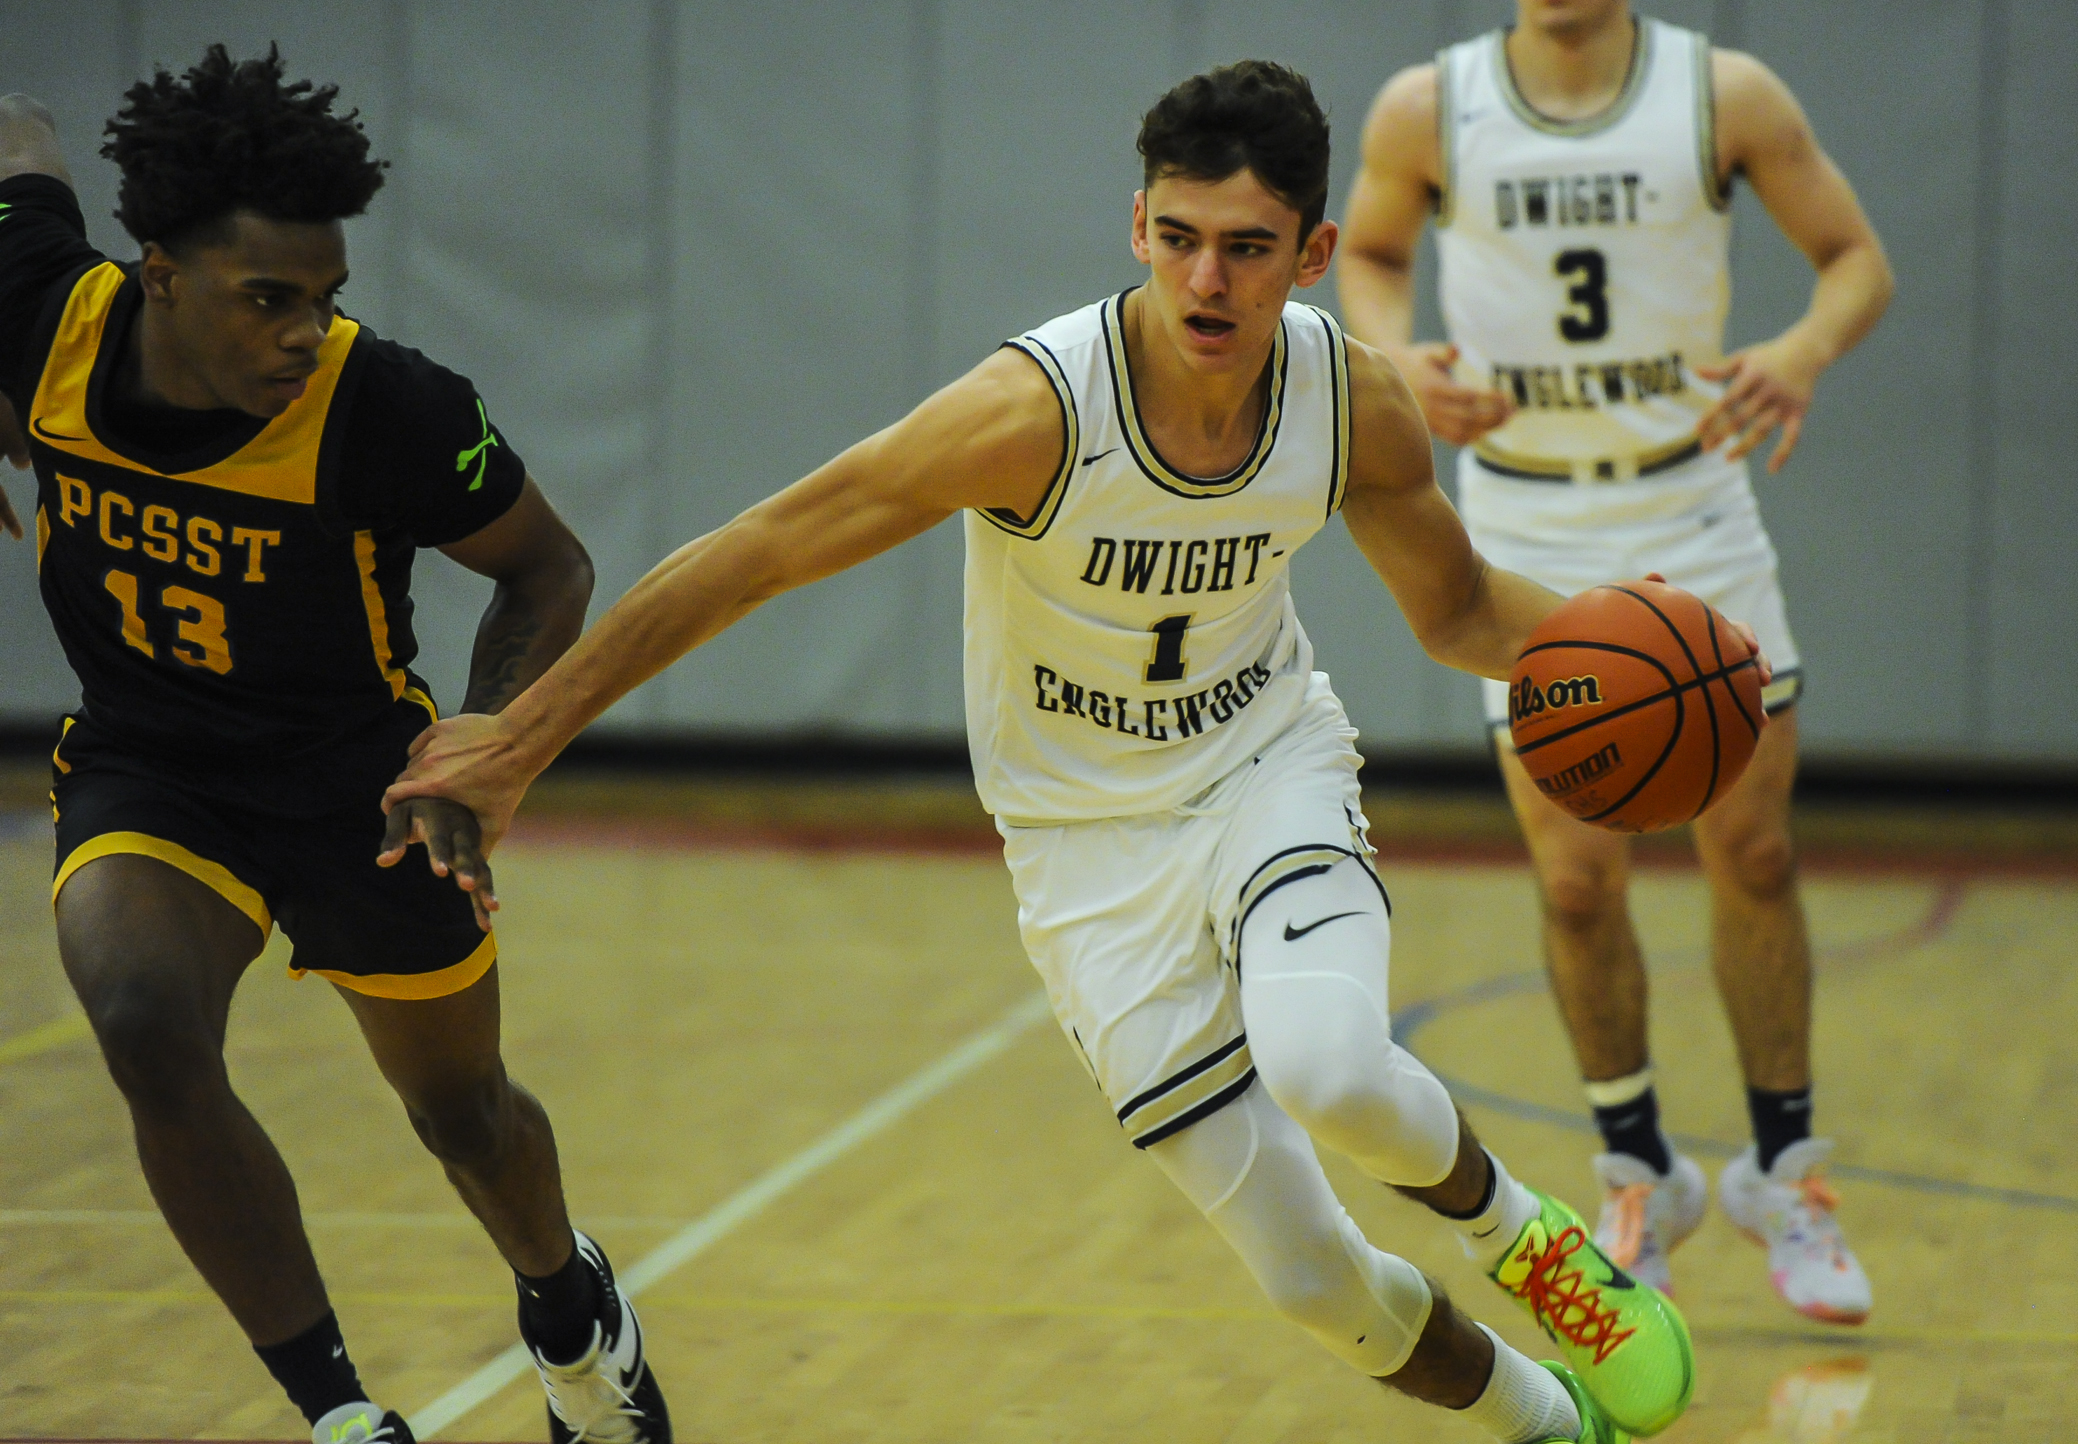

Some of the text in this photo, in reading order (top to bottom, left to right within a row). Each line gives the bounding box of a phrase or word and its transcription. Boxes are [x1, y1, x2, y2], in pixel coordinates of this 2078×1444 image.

[1555, 248, 1610, 341] 3
[55, 472, 281, 583] PCSST
[1079, 532, 1285, 595] DWIGHT-
[104, 568, 233, 676] 13
[1144, 613, 1194, 684] 1
[1510, 674, 1603, 727] ilson
